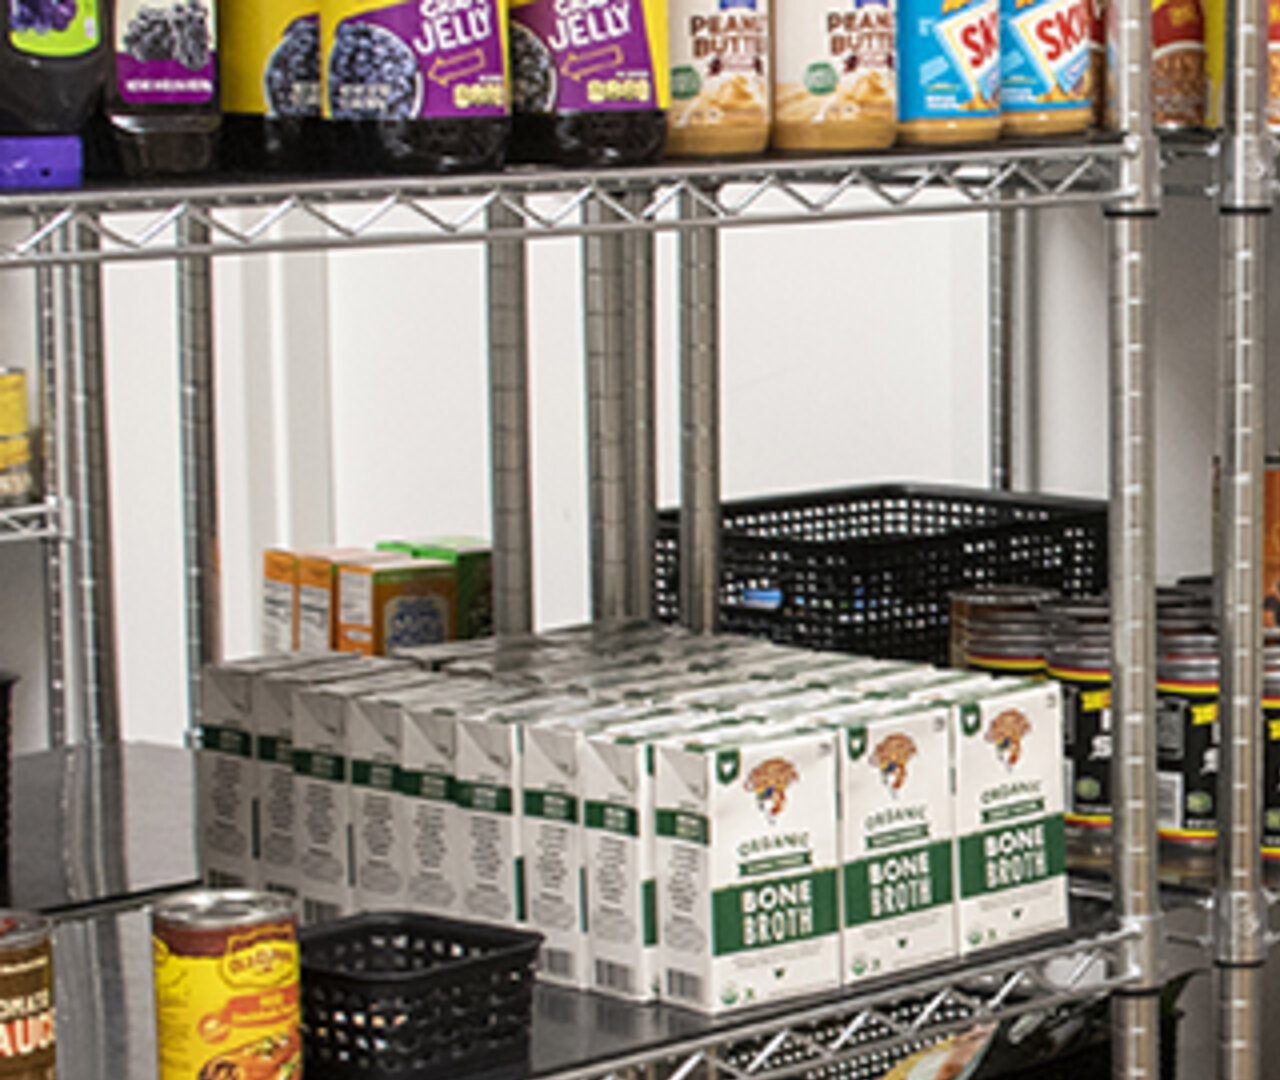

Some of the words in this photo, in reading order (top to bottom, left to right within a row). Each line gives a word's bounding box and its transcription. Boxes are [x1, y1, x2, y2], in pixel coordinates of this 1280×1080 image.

[413, 2, 493, 53] JELLY
[549, 4, 631, 50] JELLY
[690, 15, 764, 34] PEAN
[827, 12, 893, 33] PEAN
[830, 34, 894, 56] BUTT
[980, 780, 1042, 805] ORGANIC
[865, 806, 928, 832] ORGANIC
[737, 832, 811, 858] ORGANIC
[984, 826, 1045, 858] BONE
[868, 852, 930, 886] BONE
[985, 851, 1048, 889] BROTH
[742, 880, 813, 914] BONE
[870, 878, 932, 917] BROTH
[743, 907, 813, 946] BROTH
